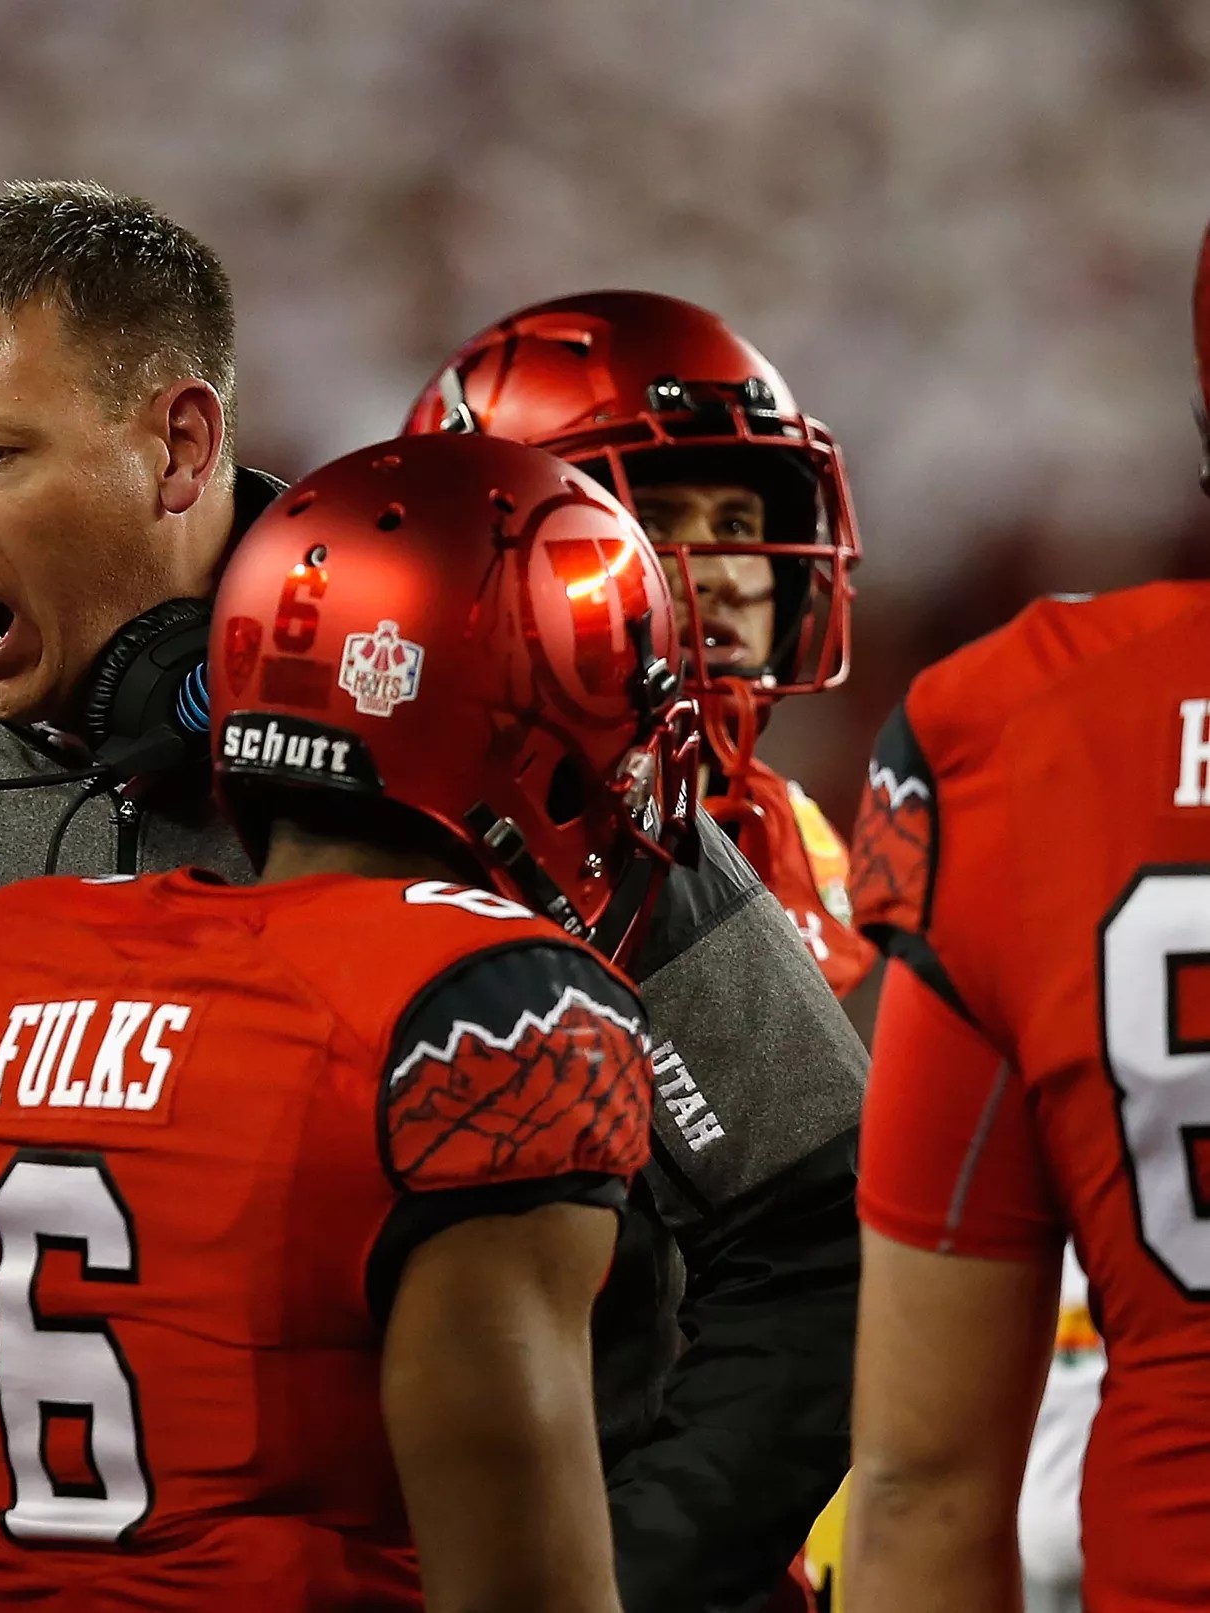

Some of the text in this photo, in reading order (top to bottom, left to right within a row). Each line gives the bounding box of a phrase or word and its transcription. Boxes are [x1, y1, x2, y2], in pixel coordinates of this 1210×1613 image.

[272, 565, 329, 654] 6
[224, 720, 351, 773] schutt
[650, 1040, 726, 1153] UTAH
